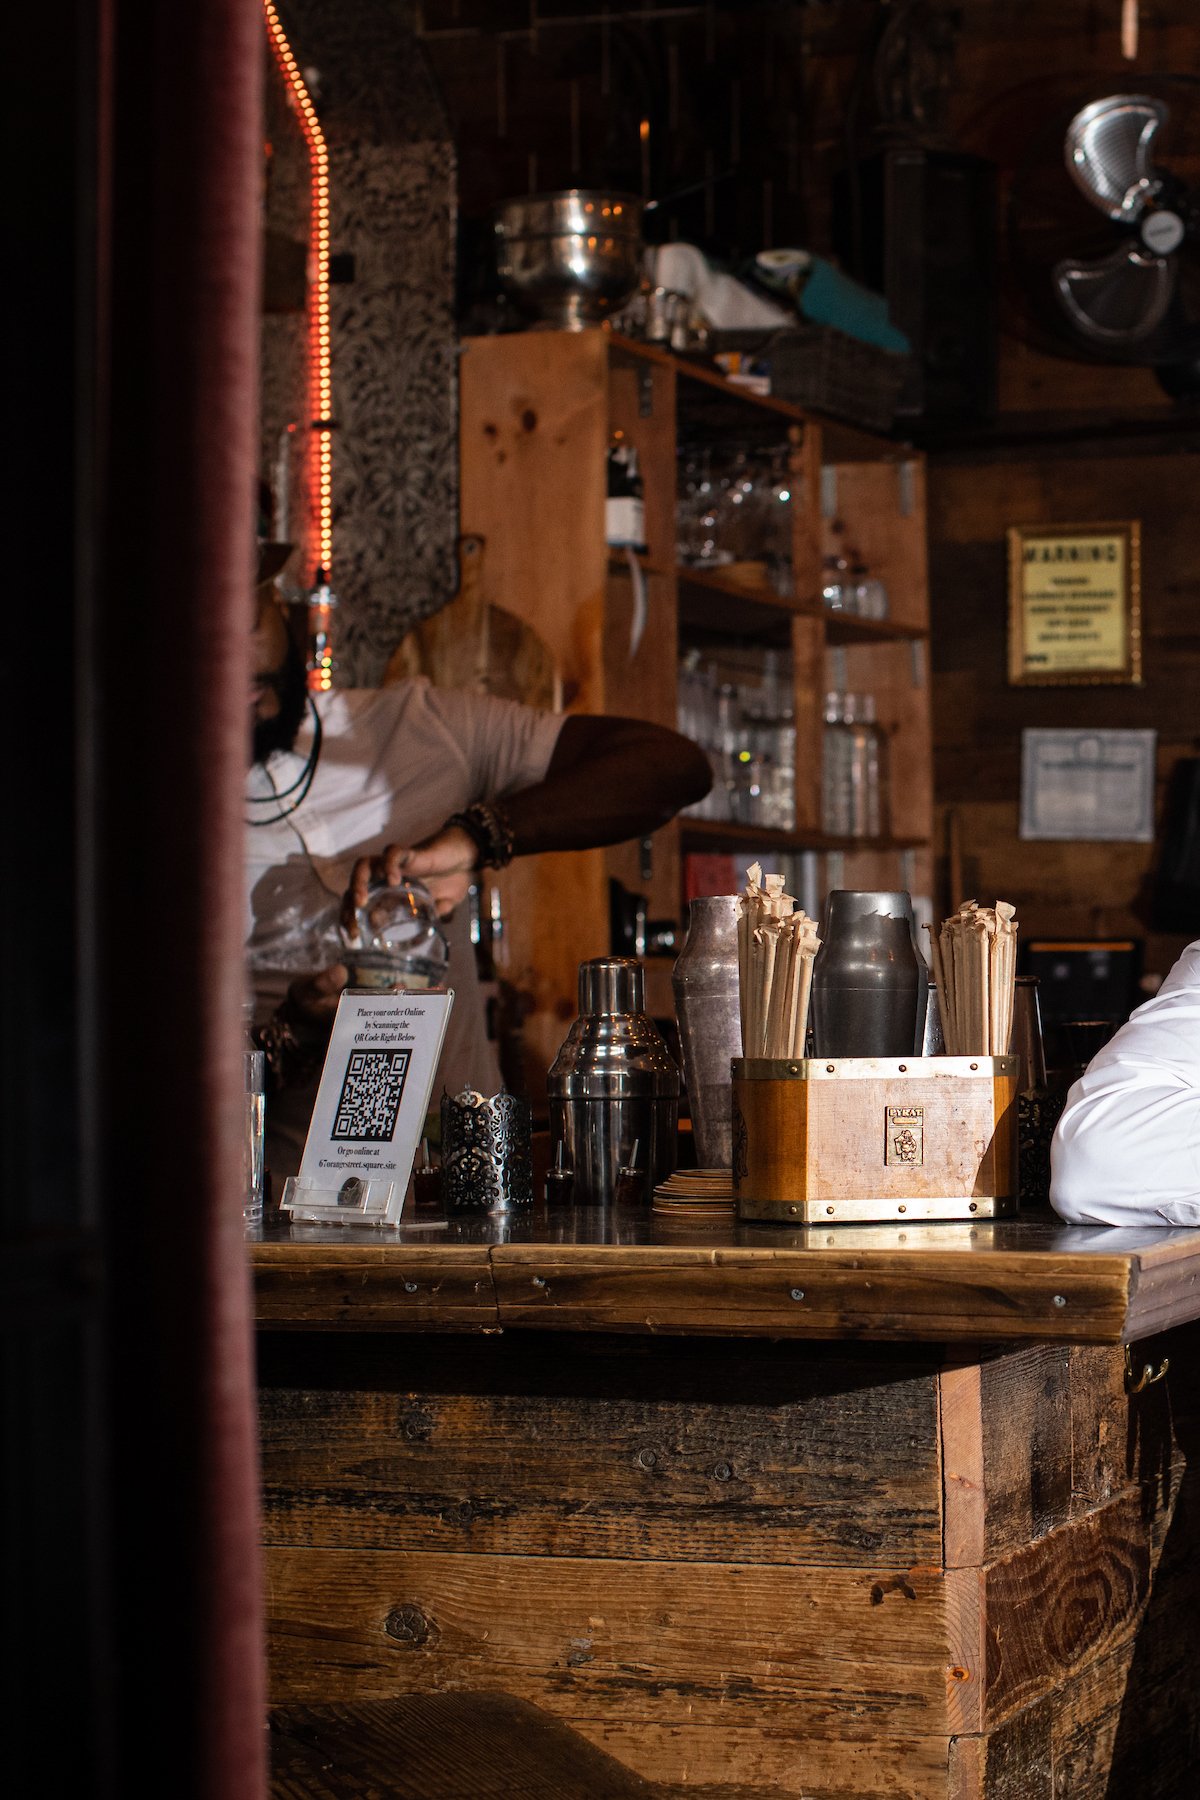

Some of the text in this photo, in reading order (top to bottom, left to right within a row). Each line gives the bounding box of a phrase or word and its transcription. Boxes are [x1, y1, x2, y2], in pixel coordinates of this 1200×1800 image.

[357, 1007, 426, 1019] Place your order Online
[364, 1020, 410, 1032] by Scanning the
[354, 1032, 416, 1043] QR Code Right Below
[337, 1145, 380, 1157] Or go online at
